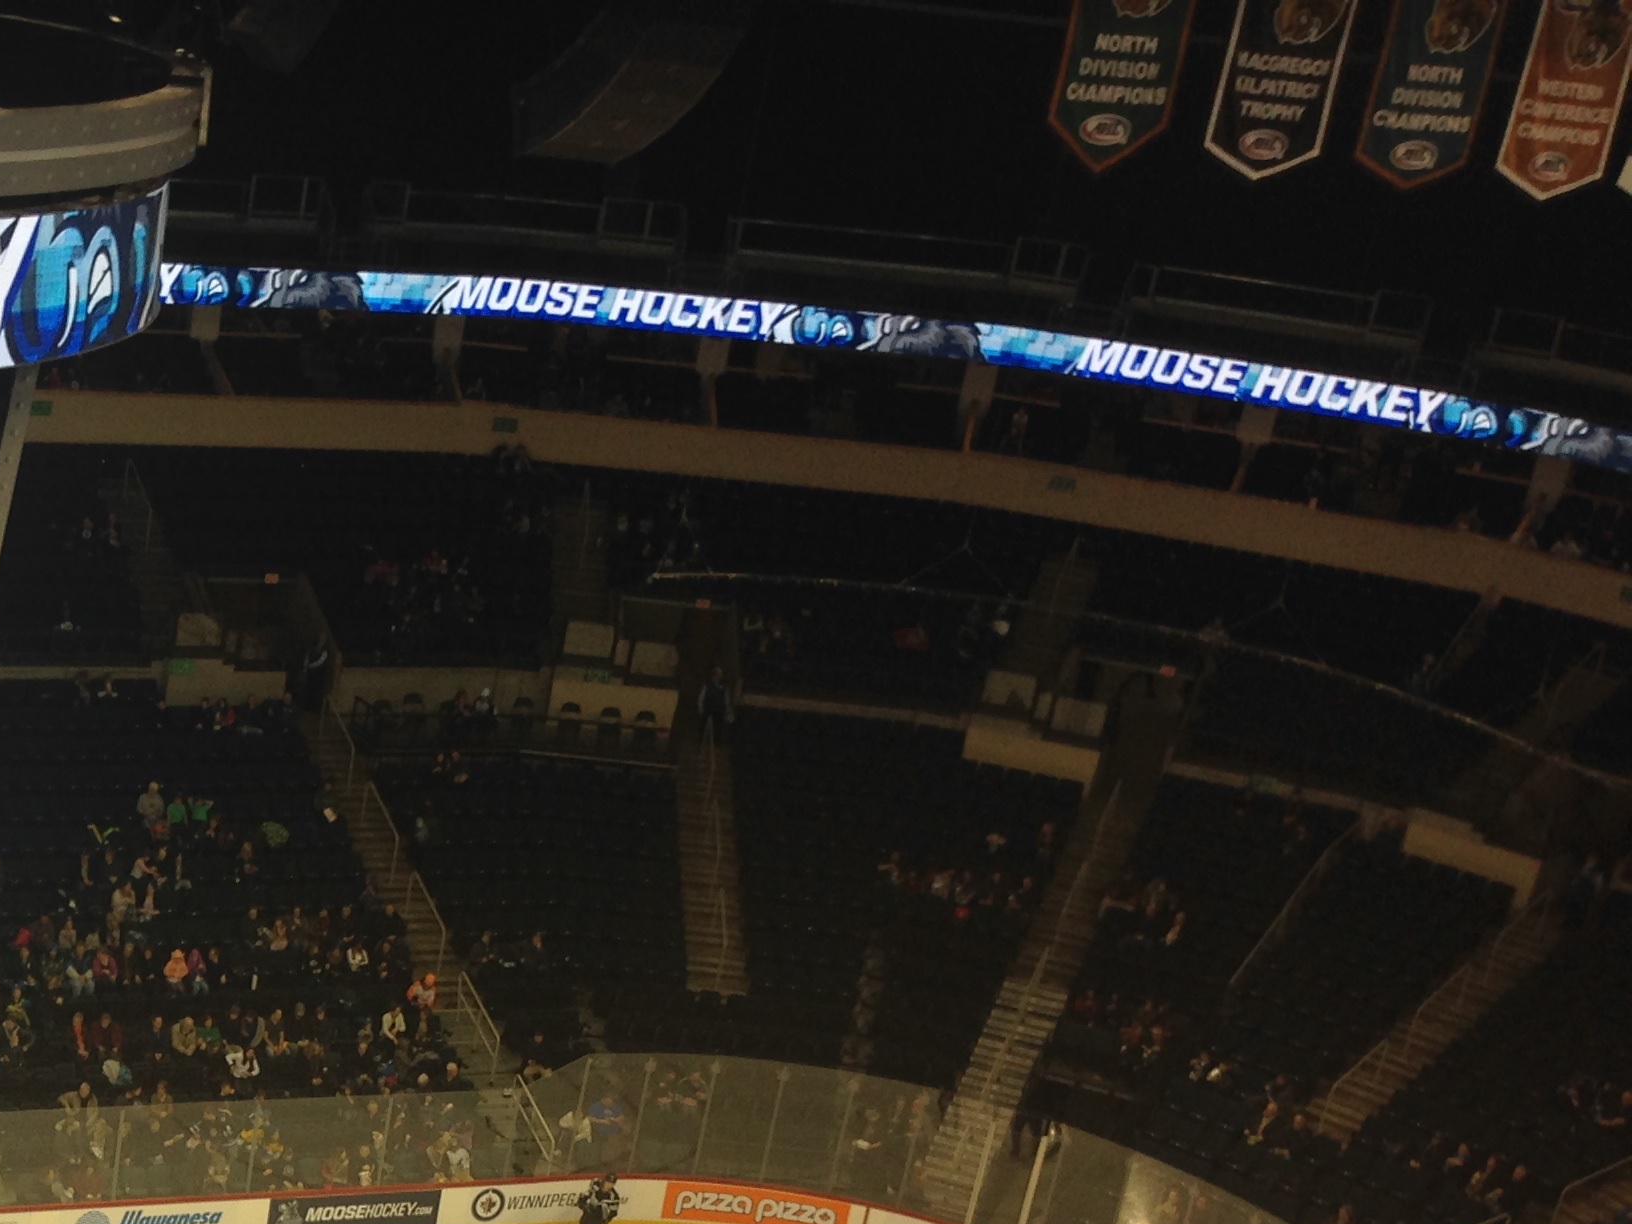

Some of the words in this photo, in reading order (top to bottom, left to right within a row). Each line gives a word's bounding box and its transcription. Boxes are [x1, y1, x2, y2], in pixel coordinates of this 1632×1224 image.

[1094, 32, 1159, 54] NORTH
[1079, 57, 1160, 80] DIVISION
[1407, 63, 1464, 84] NORTH
[1066, 81, 1167, 105] CHAMPIONS
[452, 275, 601, 320] MOOSE
[607, 286, 788, 338] HOCKEY
[1076, 339, 1245, 394] MOOSE
[1251, 364, 1446, 431] HOCKEY
[674, 1190, 752, 1215] pizza
